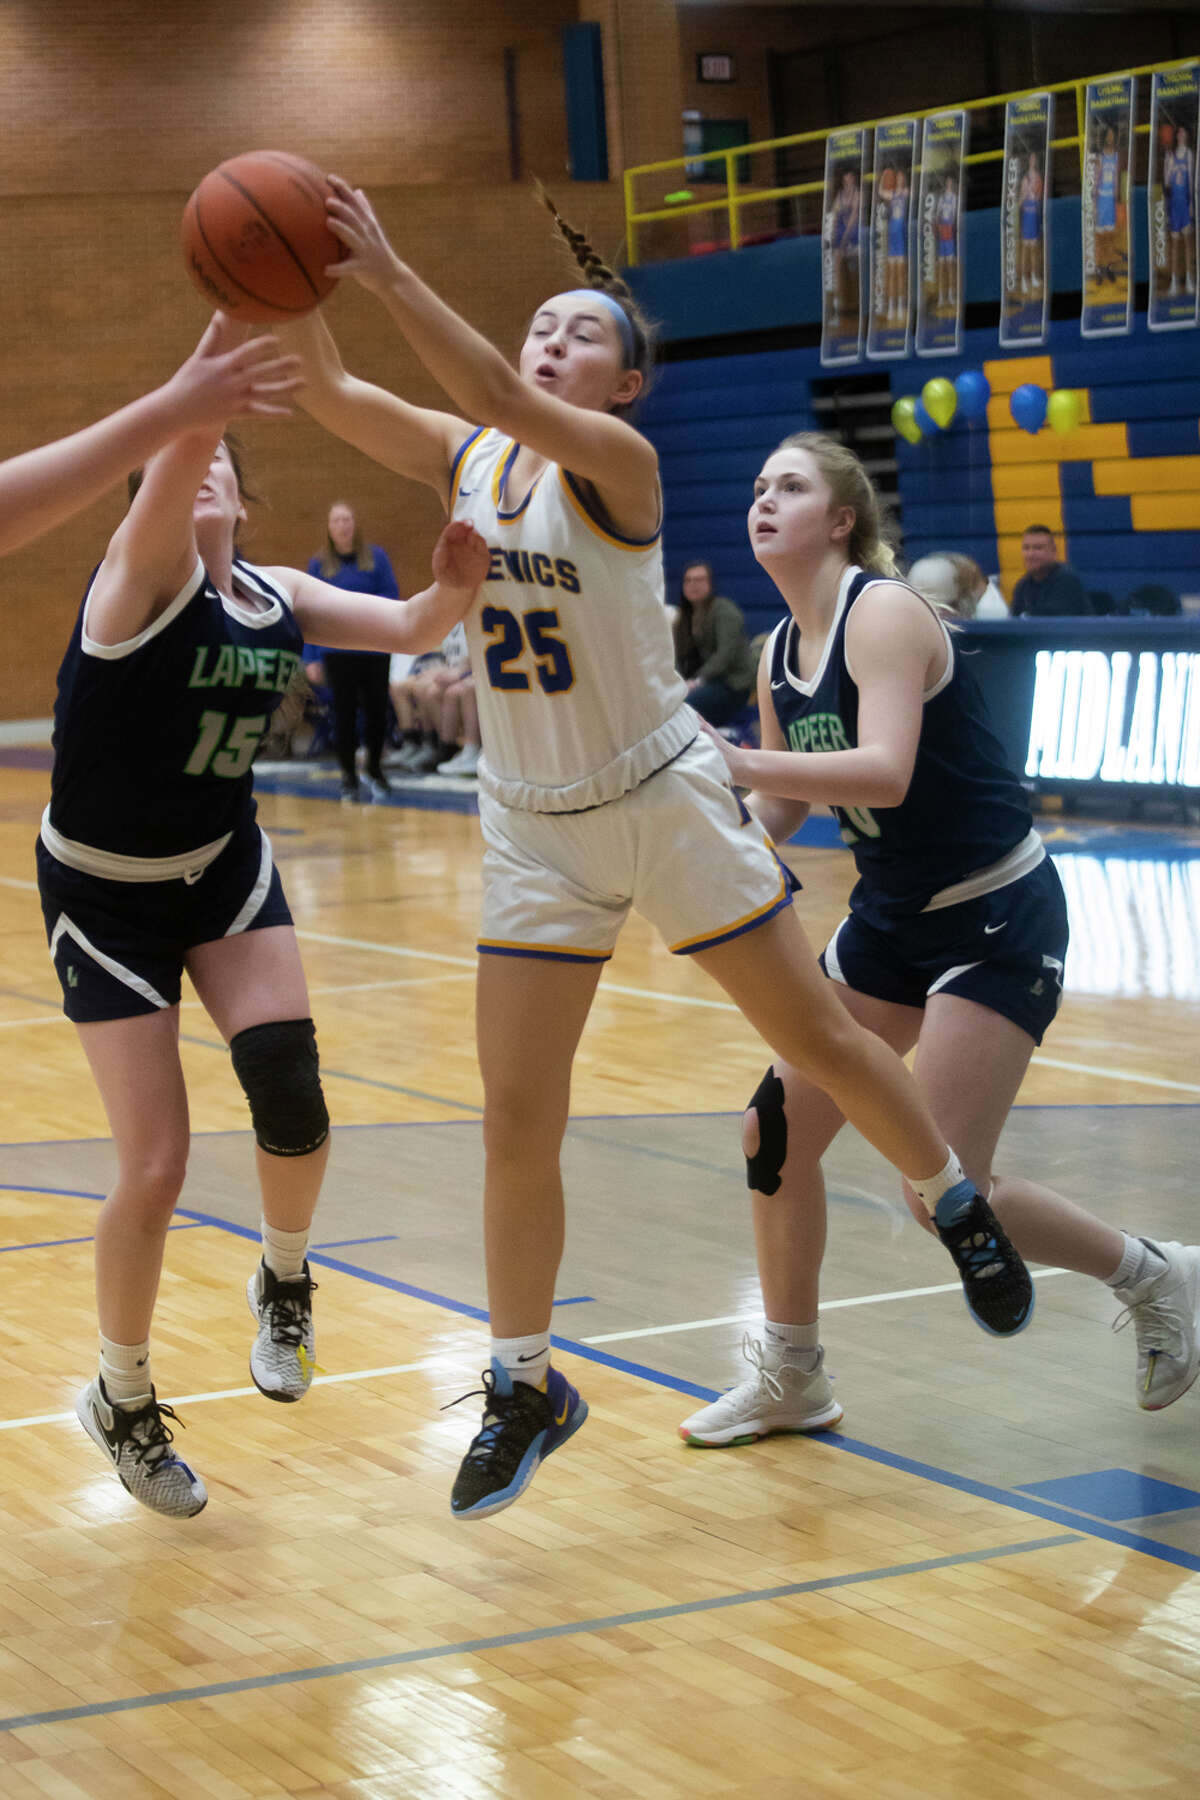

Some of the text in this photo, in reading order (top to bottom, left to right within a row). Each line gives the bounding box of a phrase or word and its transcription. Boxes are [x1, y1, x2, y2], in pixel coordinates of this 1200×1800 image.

[187, 644, 302, 692] LAPEE
[480, 603, 577, 697] 25
[183, 709, 268, 779] 15
